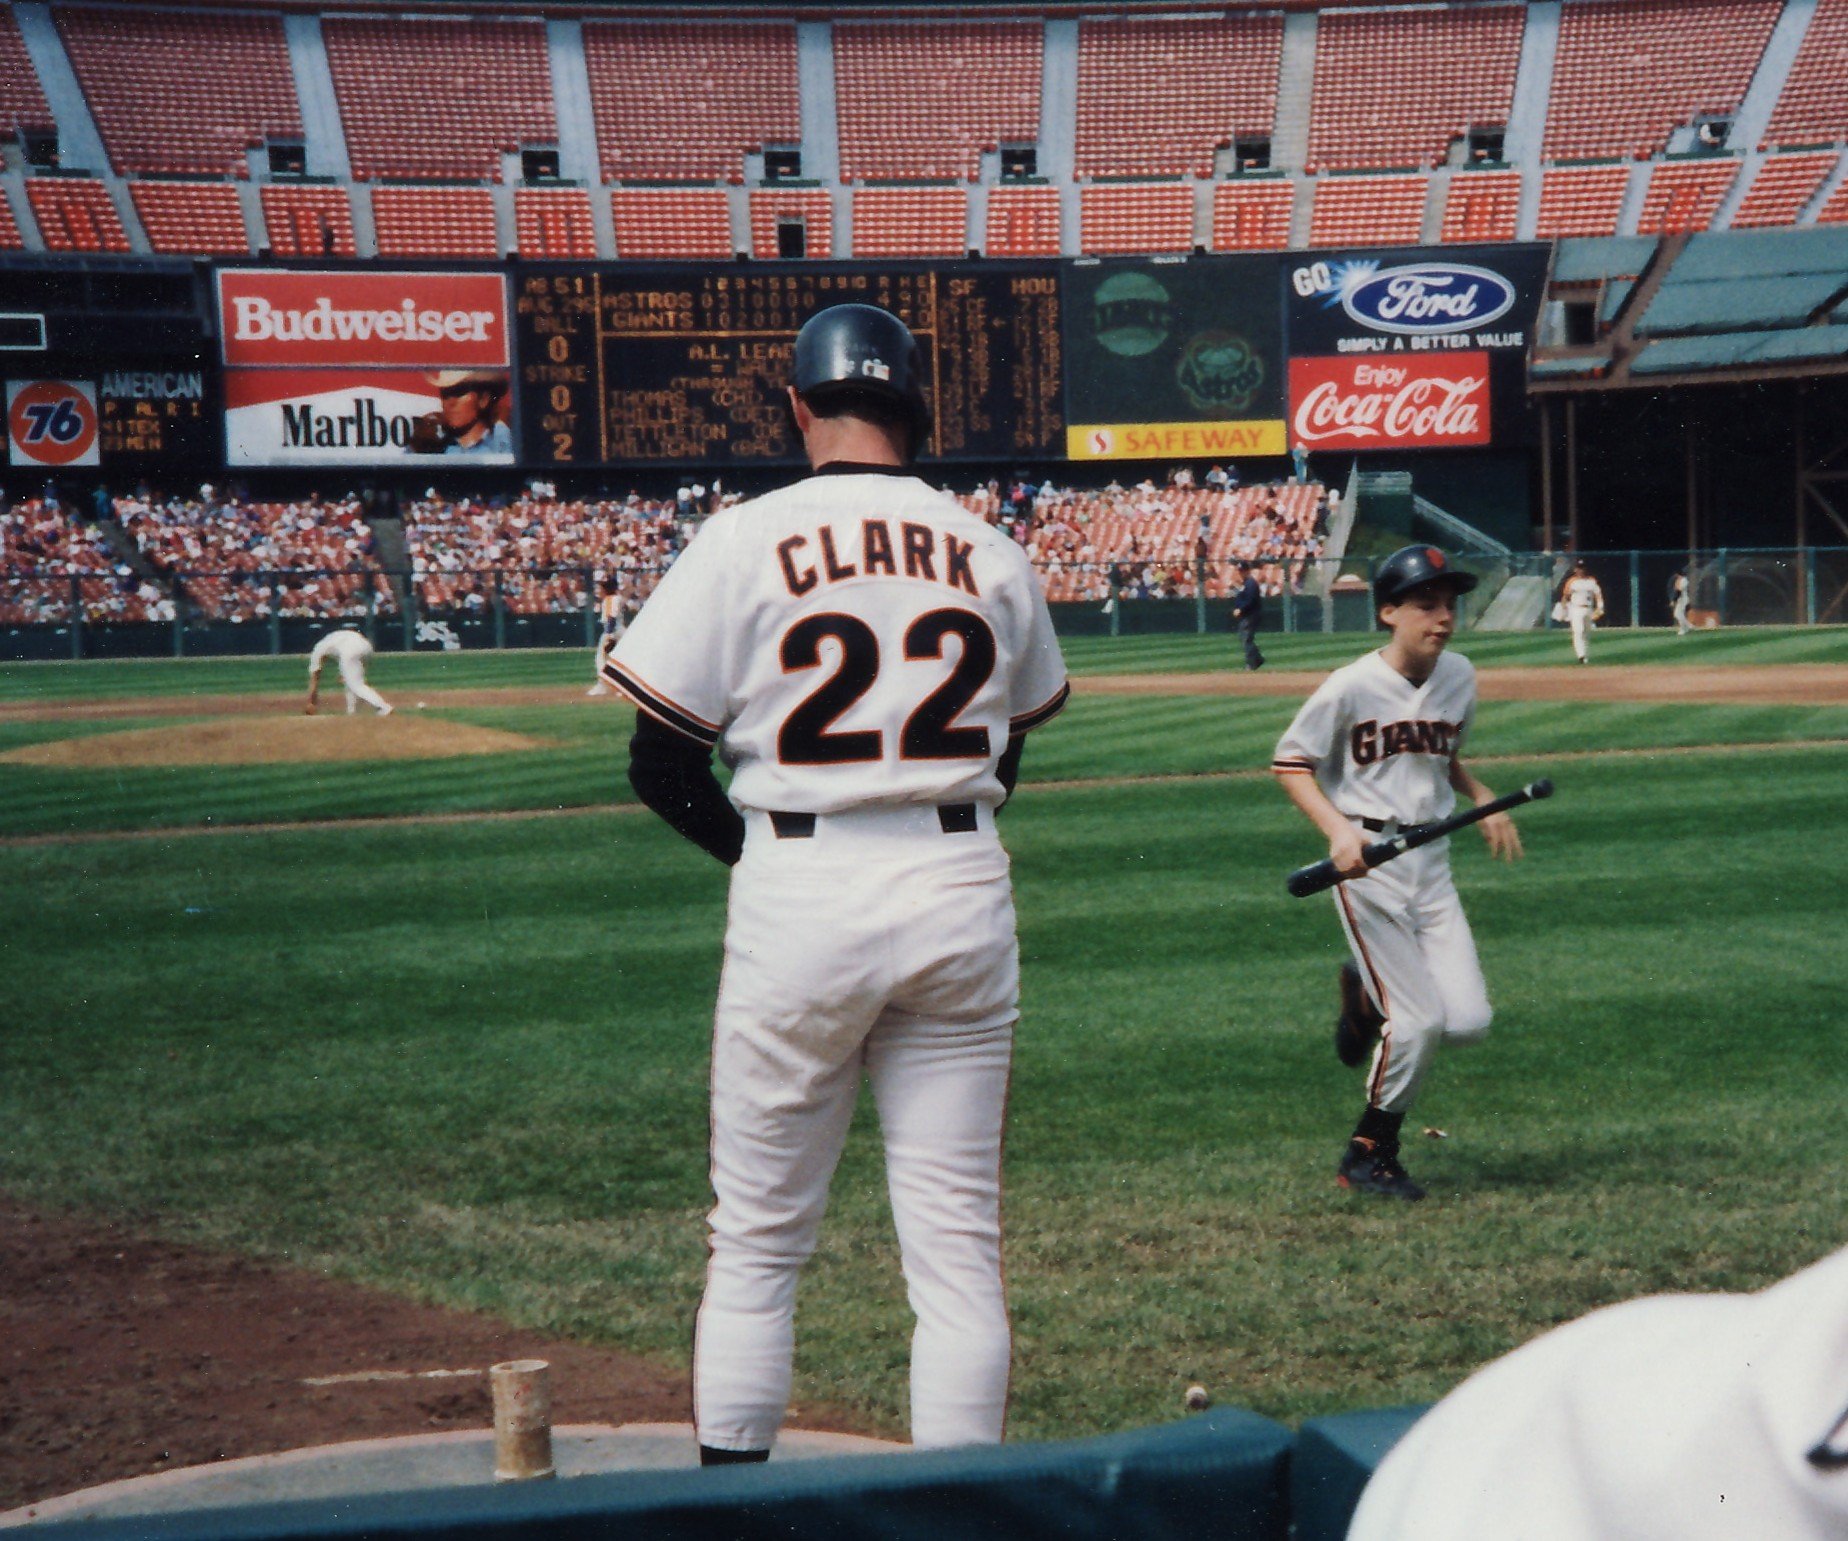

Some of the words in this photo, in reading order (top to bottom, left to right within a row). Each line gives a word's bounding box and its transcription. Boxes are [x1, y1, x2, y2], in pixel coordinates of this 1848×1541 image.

[950, 279, 977, 296] SF
[1011, 278, 1056, 295] HOU
[1292, 262, 1331, 297] GO
[602, 292, 693, 309] ASTROS
[1378, 276, 1479, 319] Ford
[233, 298, 495, 342] Budweiser
[612, 310, 694, 329] GIANTS
[549, 335, 569, 362] 0
[739, 342, 797, 360] LEAD
[1337, 337, 1388, 352] SIMPLY
[1394, 336, 1404, 349] A
[1411, 334, 1470, 350] BETTER
[1476, 332, 1524, 347] VALUE
[100, 372, 203, 399] AMERICAN
[1354, 364, 1407, 388] Enjoy
[550, 385, 571, 412] 0
[1295, 376, 1485, 440] Coca-Cola
[20, 397, 83, 444] 76
[281, 398, 424, 448] Marlbo
[553, 433, 573, 461] 2
[1125, 428, 1264, 455] SAFEWAY
[776, 519, 981, 598] CLARK
[777, 607, 997, 766] 22
[1351, 719, 1464, 766] GIANT
